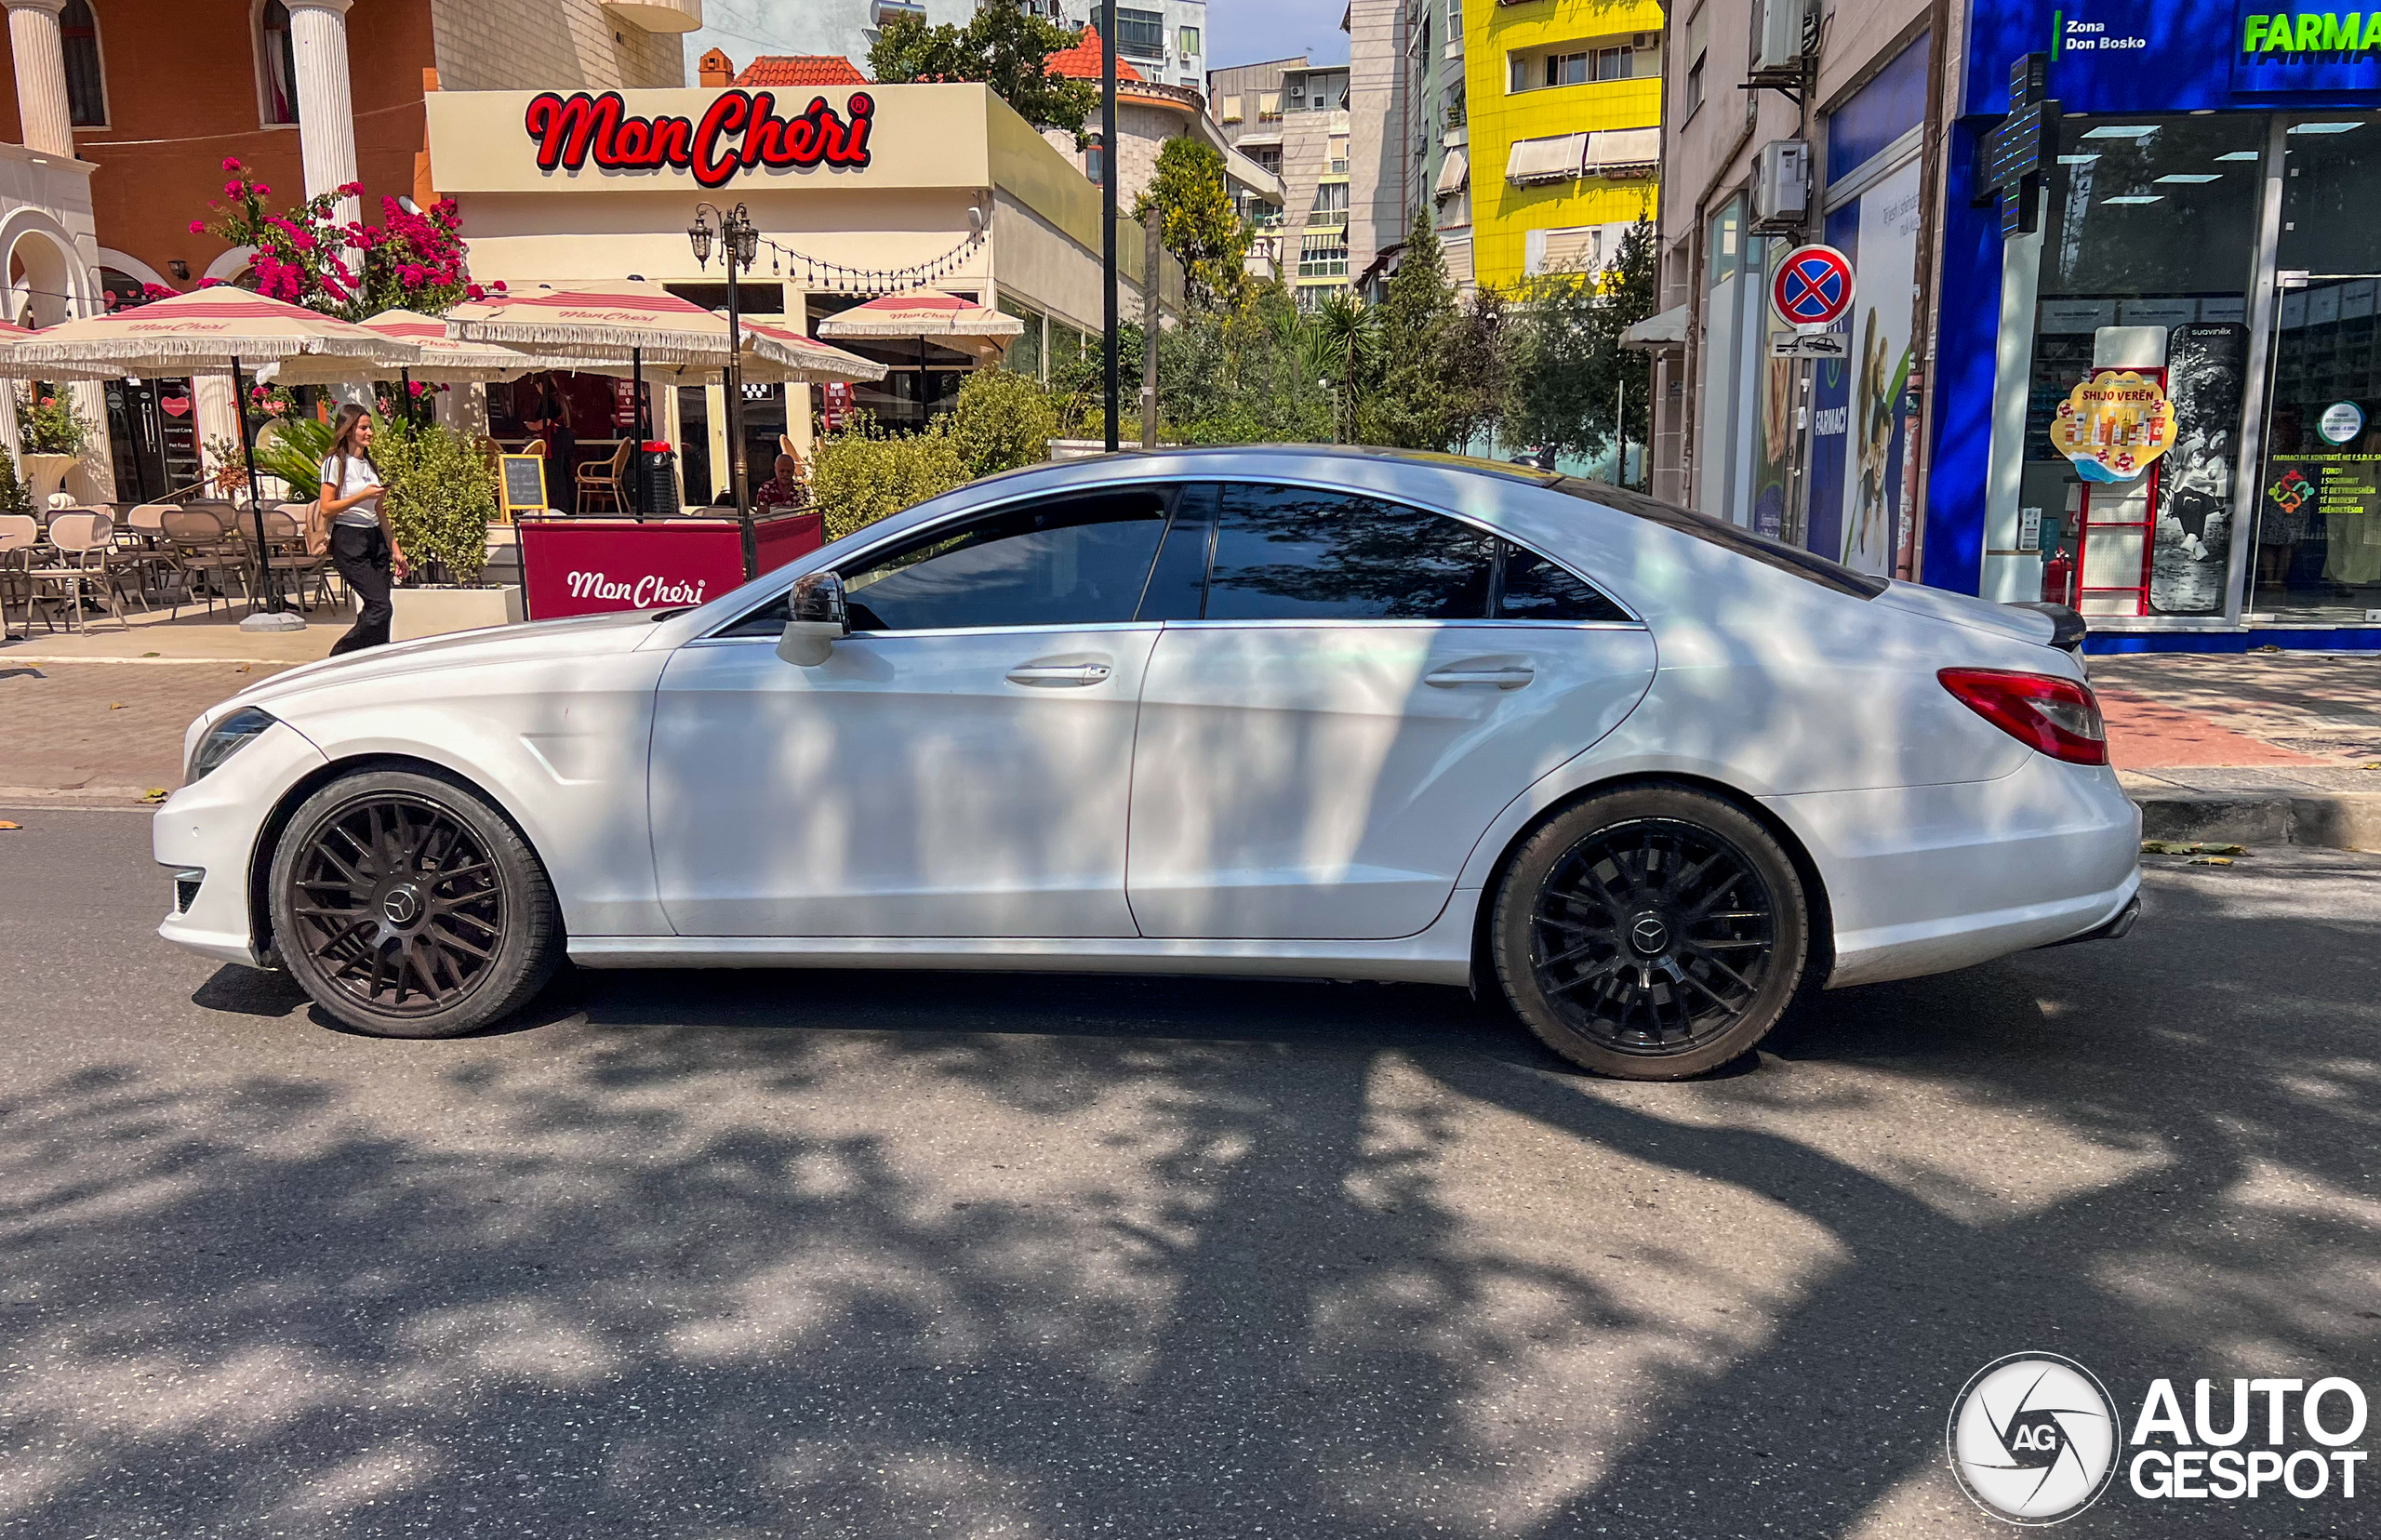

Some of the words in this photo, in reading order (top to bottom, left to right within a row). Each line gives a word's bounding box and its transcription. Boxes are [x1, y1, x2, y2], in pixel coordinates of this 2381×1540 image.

[2067, 20, 2105, 33] Zona
[2066, 37, 2095, 49] Don
[2099, 36, 2146, 49] Bosko
[526, 92, 692, 169] Mon
[2082, 391, 2114, 401] SHIJO
[2118, 389, 2154, 401] VERËN
[1816, 406, 1847, 436] FARMACI
[2321, 467, 2343, 475] FONDI
[567, 571, 632, 600] Mon
